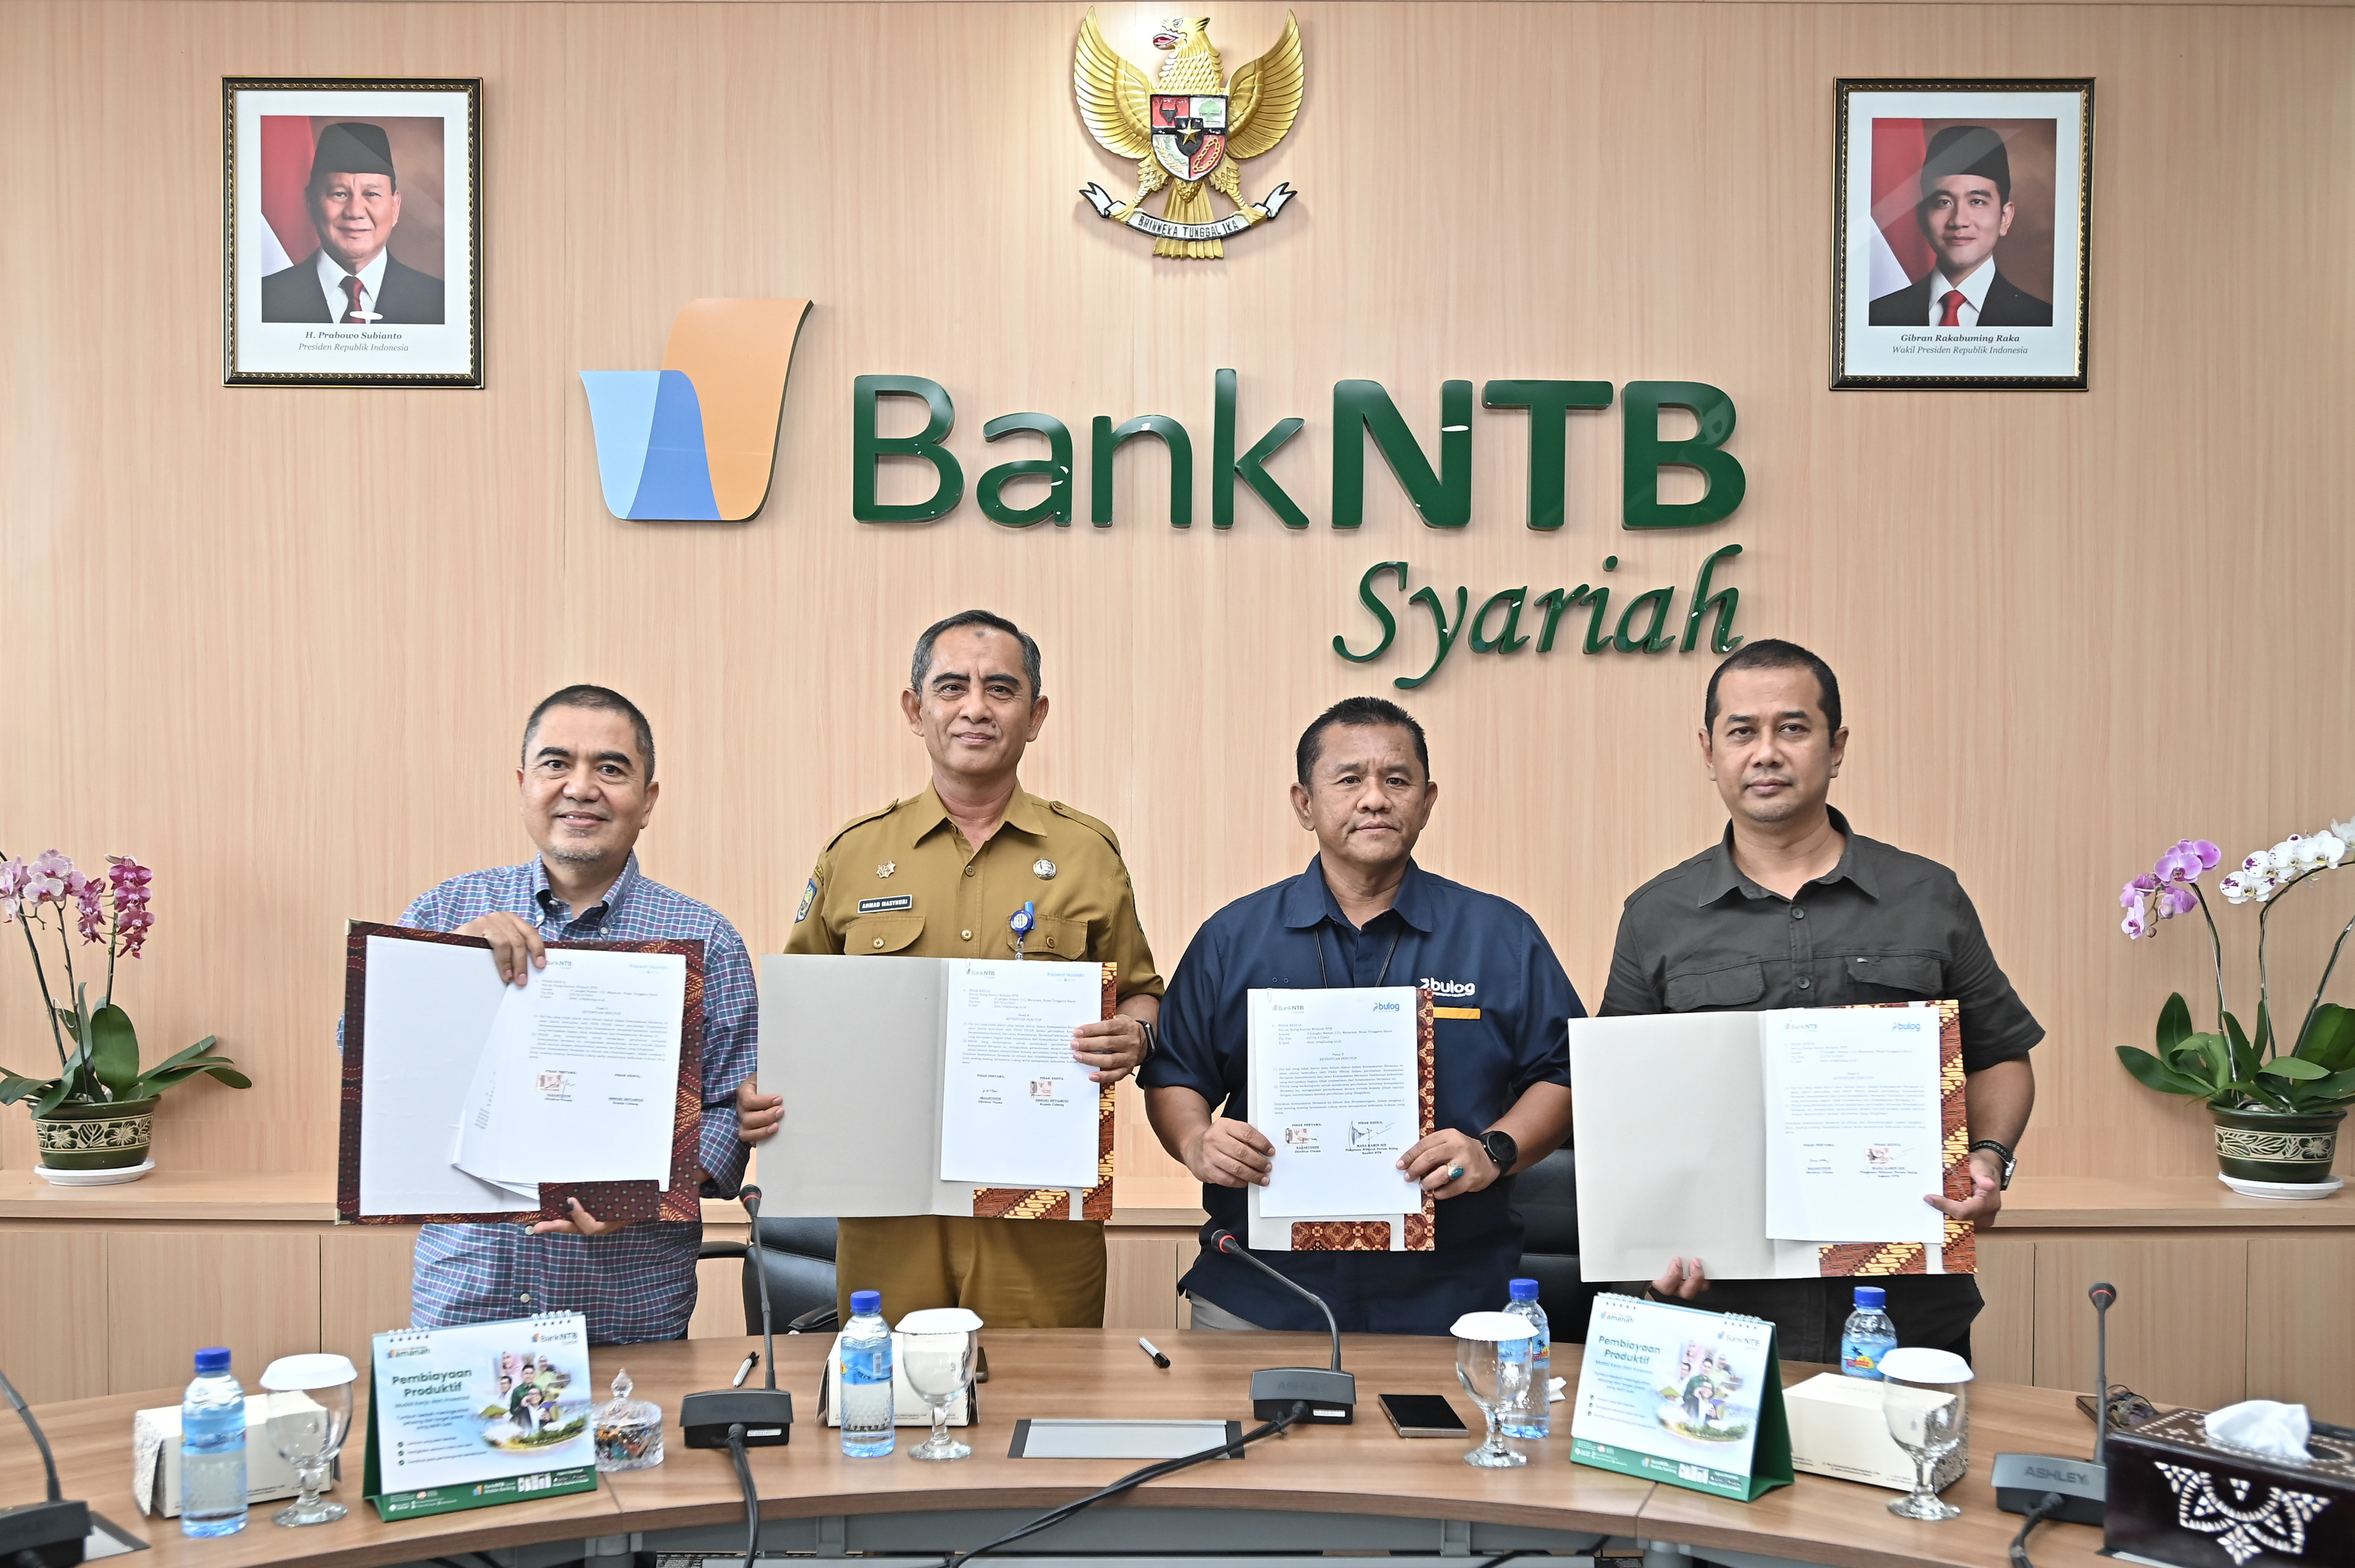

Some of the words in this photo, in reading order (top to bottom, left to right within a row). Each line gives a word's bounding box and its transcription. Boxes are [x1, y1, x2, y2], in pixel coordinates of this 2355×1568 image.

[1138, 215, 1178, 237] BHINNEKA
[1183, 225, 1221, 238] TUNGGAL
[1225, 220, 1239, 235] IKA
[318, 331, 359, 339] Prabowo
[1935, 334, 1993, 344] Rakabuming
[334, 343, 368, 352] Republik
[1953, 346, 1987, 355] Republik
[1333, 544, 1746, 689] Syariah
[1431, 977, 1475, 996] bulog
[1378, 1002, 1400, 1012] bulog
[1898, 1022, 1921, 1031] bulog
[1607, 1314, 1634, 1324] amanah
[1599, 1335, 1661, 1354] Pembiayaan
[1605, 1349, 1650, 1365] Produktif
[392, 1369, 472, 1385] Pembiayaan
[404, 1381, 461, 1397] Produktif
[2025, 1466, 2088, 1485] ASHLEY
